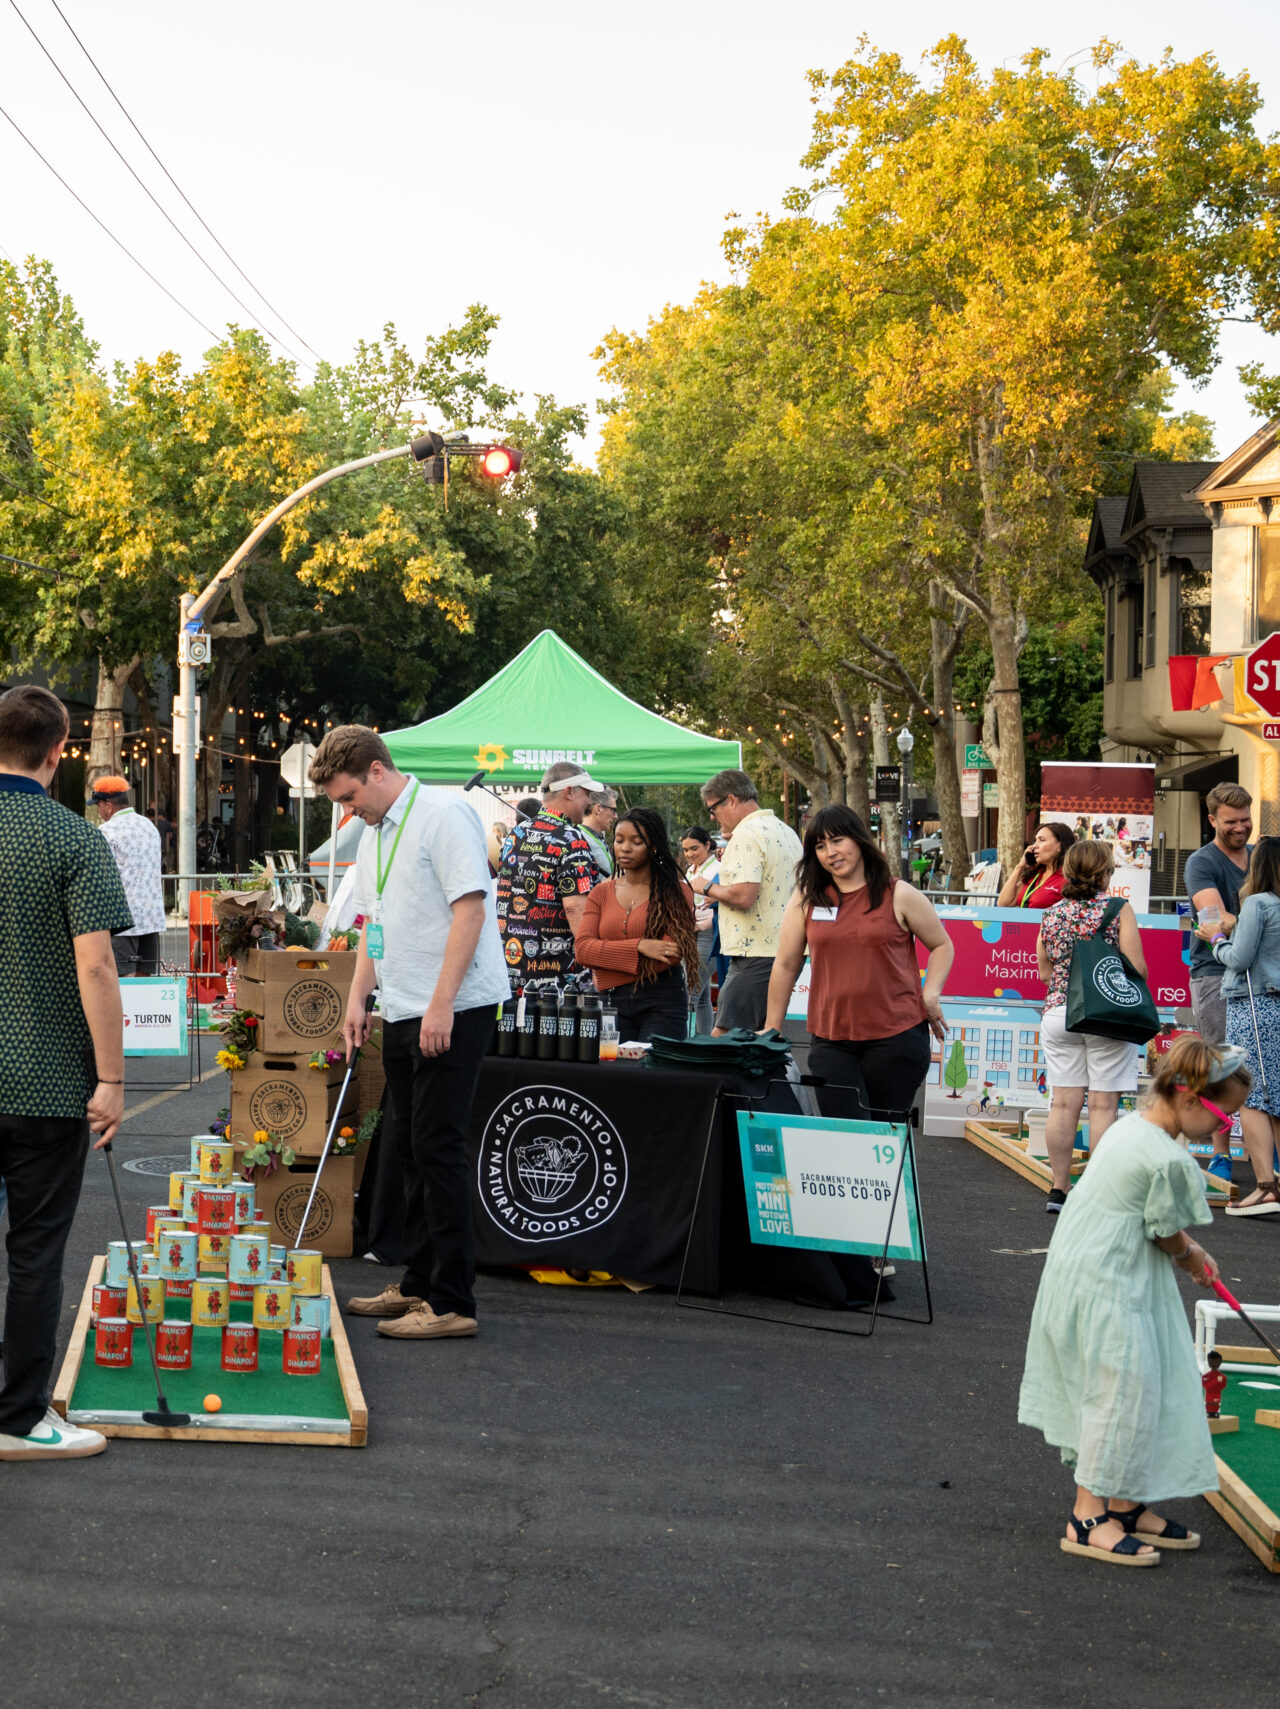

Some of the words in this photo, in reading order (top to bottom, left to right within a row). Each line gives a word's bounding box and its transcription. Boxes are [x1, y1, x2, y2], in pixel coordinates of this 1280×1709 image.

[512, 749, 597, 765] SUNBELT
[161, 989, 175, 1001] 23
[290, 983, 335, 1000] SACRAMENTO
[1157, 987, 1186, 1002] rse
[134, 1014, 172, 1024] TURTON
[287, 1004, 304, 1033] NATURAL
[305, 1025, 328, 1035] FOODS
[991, 1062, 1008, 1070] rse
[495, 1095, 611, 1145] SACRAMENTO
[754, 1143, 774, 1153] SKK
[872, 1144, 896, 1165] 19
[800, 1172, 852, 1185] SACRAMENTO
[854, 1177, 890, 1189] NATURAL
[282, 1187, 326, 1205] SACRAMNTO
[488, 1151, 520, 1225] NATURAL
[520, 1216, 581, 1233] FOODS
[801, 1181, 847, 1198] FOODS
[850, 1186, 892, 1202] CO-OP
[756, 1191, 788, 1211] MINI
[759, 1219, 791, 1235] LOVE
[98, 1324, 126, 1332] BIANCO
[158, 1326, 187, 1335] BIANCO
[225, 1329, 254, 1337] BIANCO
[288, 1332, 317, 1340] BIANCO
